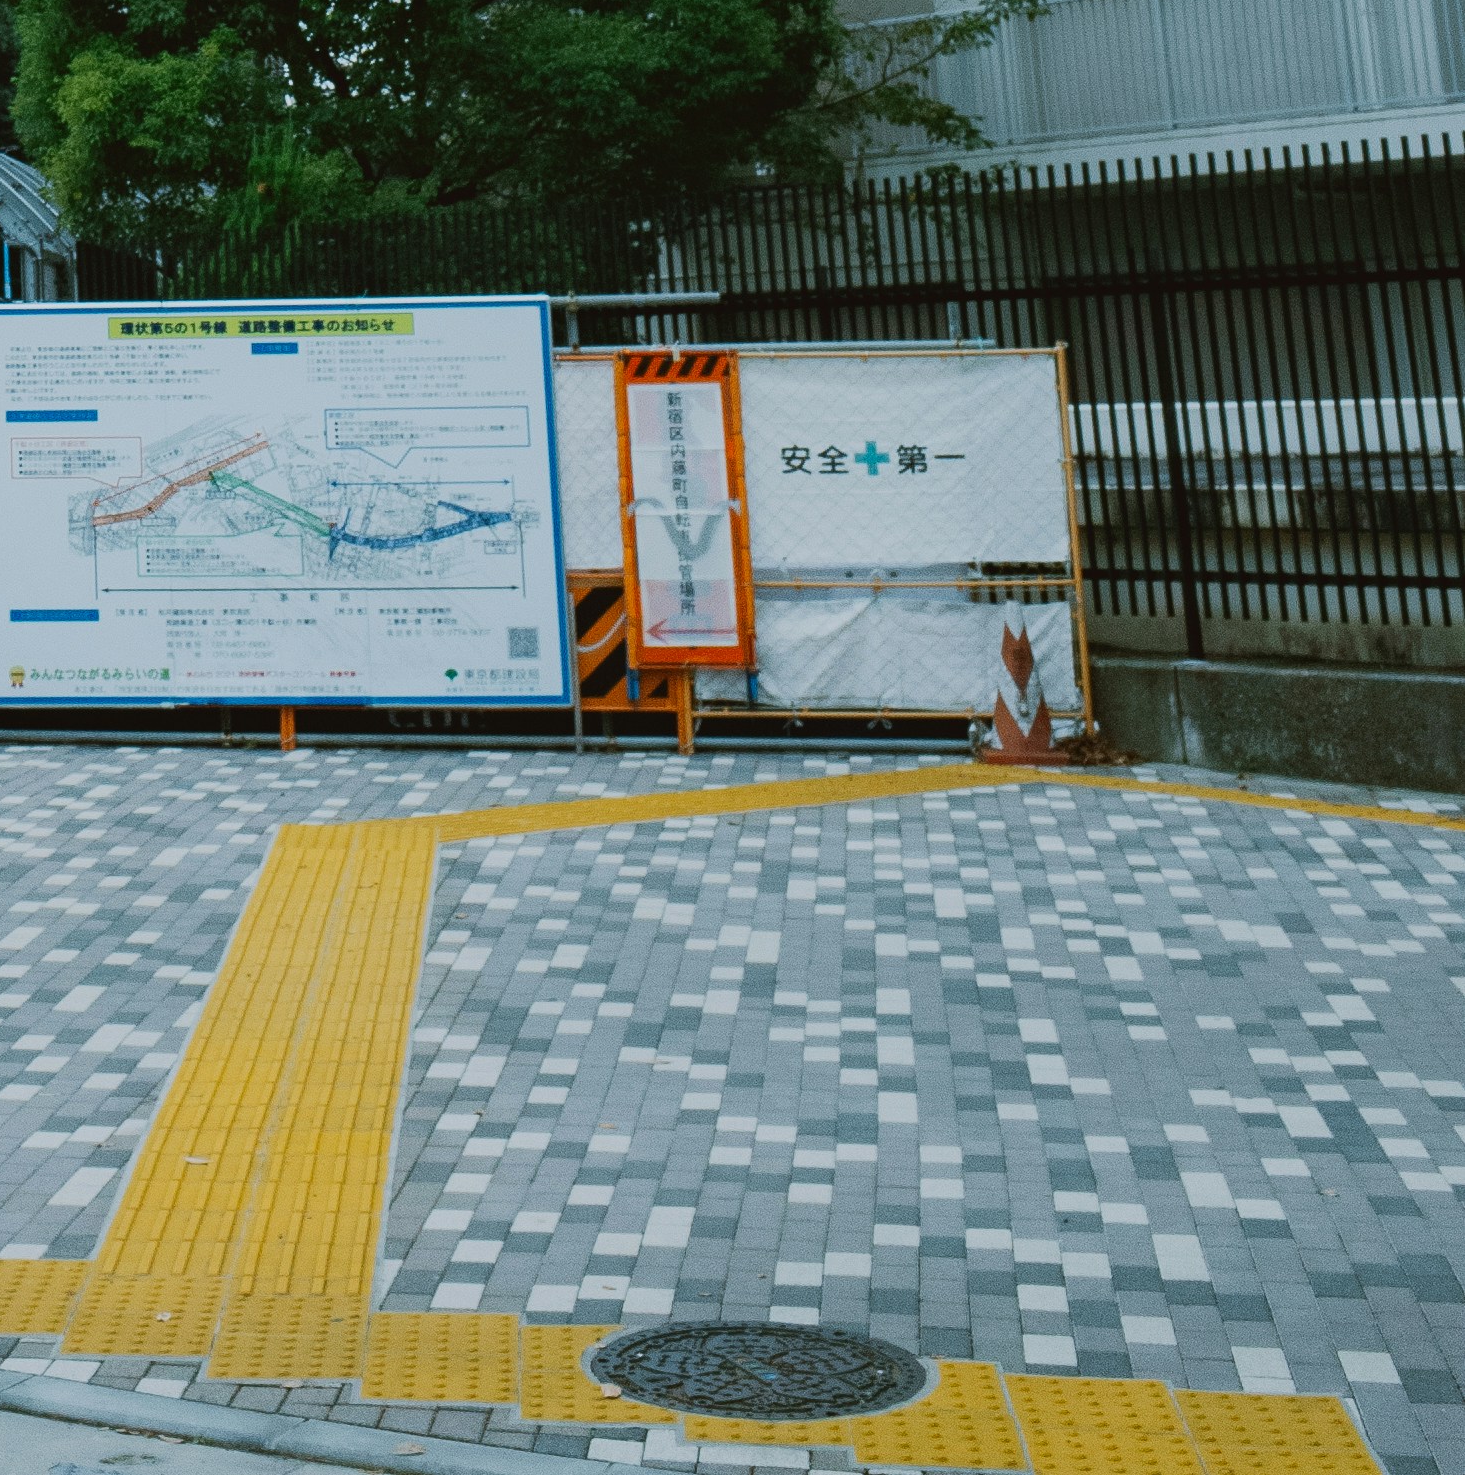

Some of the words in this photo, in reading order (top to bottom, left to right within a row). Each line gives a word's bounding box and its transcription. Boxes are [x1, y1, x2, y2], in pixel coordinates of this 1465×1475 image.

[120, 321, 227, 335] 環状第5の1号線
[239, 319, 396, 334] 道路整備工事のお知らせ
[780, 444, 850, 475] 安全
[896, 444, 966, 475] 第一
